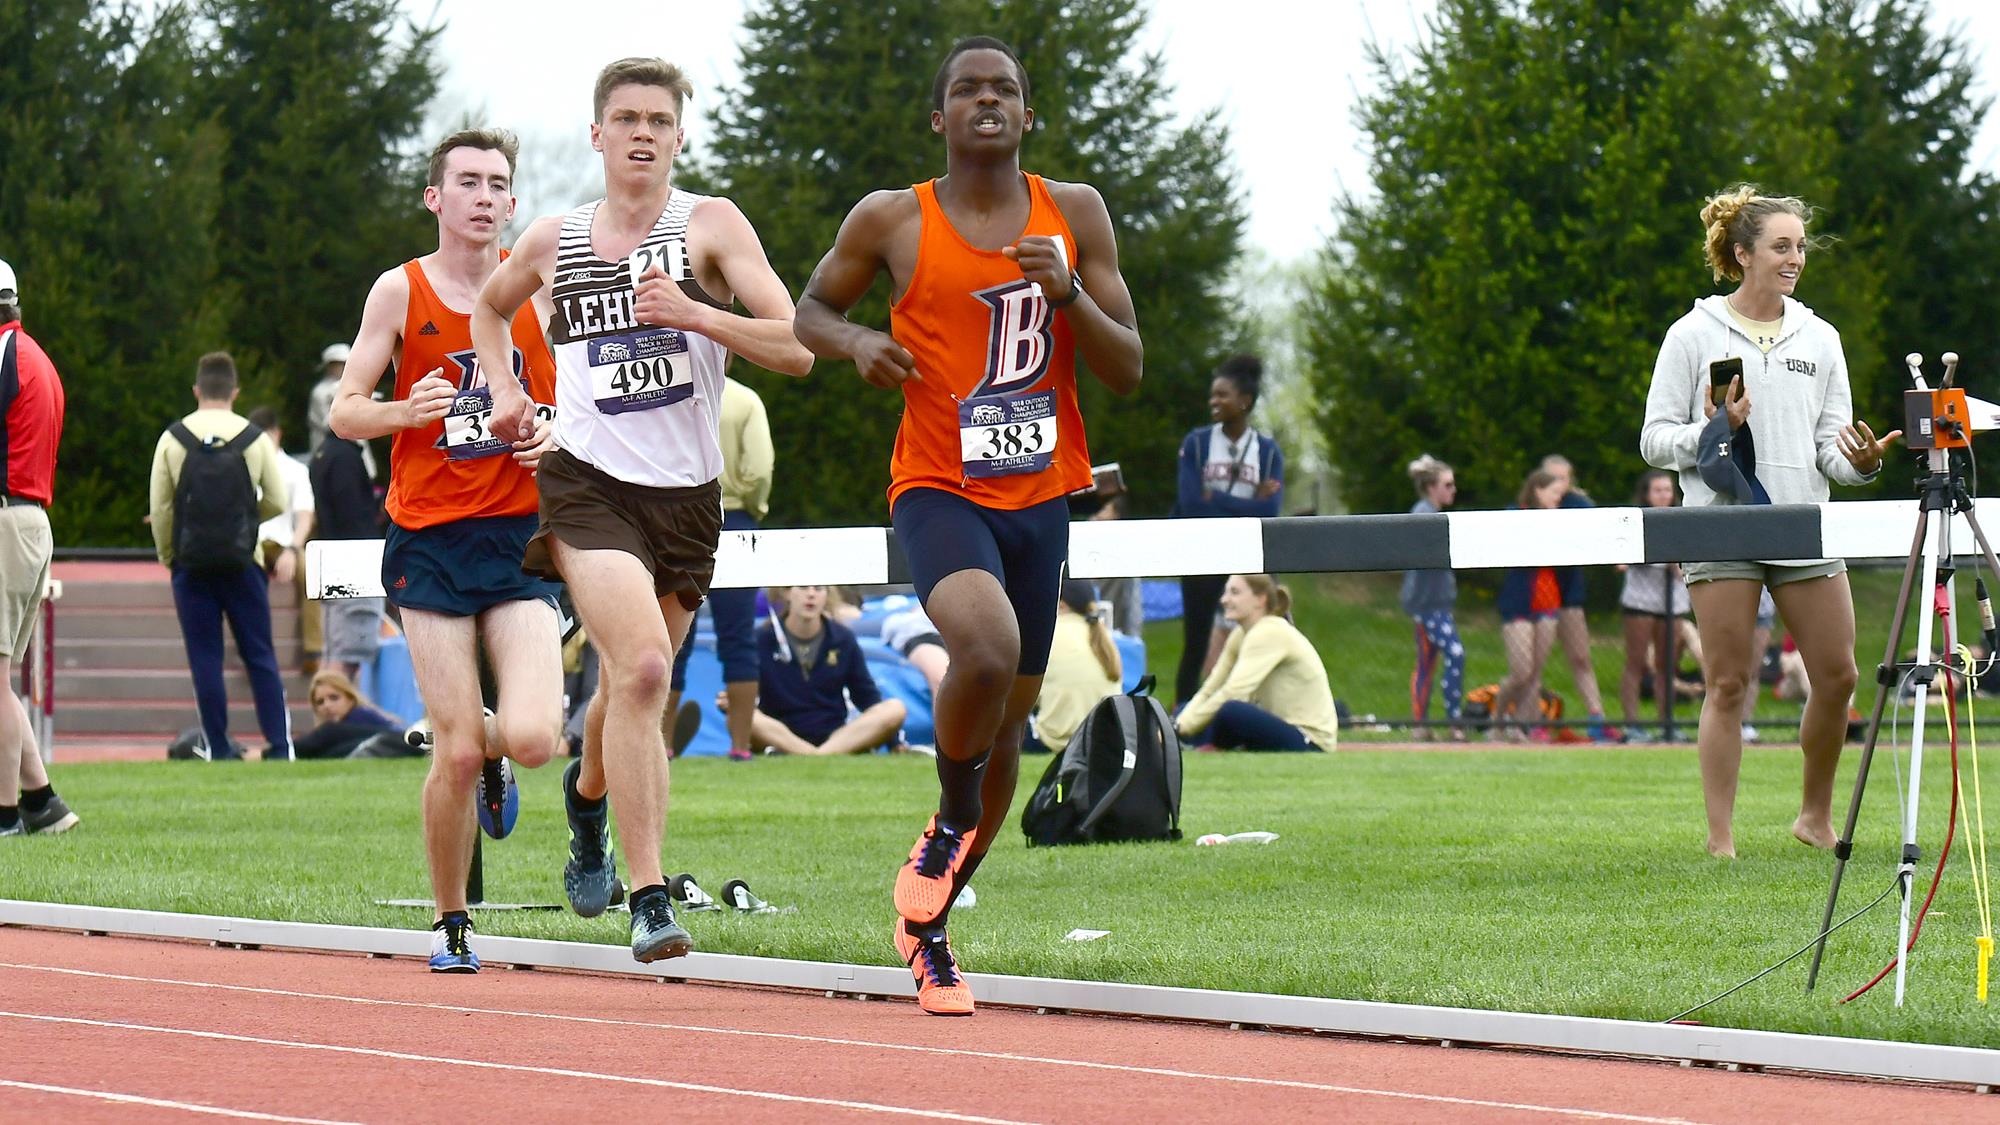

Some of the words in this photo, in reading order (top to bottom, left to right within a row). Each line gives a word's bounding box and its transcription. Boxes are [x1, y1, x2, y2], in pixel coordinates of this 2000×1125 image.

[637, 244, 671, 284] 21
[562, 289, 640, 338] LEHI
[649, 333, 678, 342] OUTDOOR
[635, 343, 681, 355] CHAMPIONSHIPS
[637, 340, 656, 349] TRACK
[611, 357, 674, 394] 490
[635, 389, 668, 400] ATHLETIC
[1010, 399, 1024, 407] 2018
[1024, 395, 1050, 405] OUTDOOR
[1012, 404, 1030, 413] TRACK
[1035, 401, 1048, 409] FIELD
[1010, 407, 1051, 419] CHAMPIONSHIPS
[487, 439, 503, 447] ATHL
[981, 421, 1043, 459] 383
[1005, 455, 1036, 465] ATHLETIC
